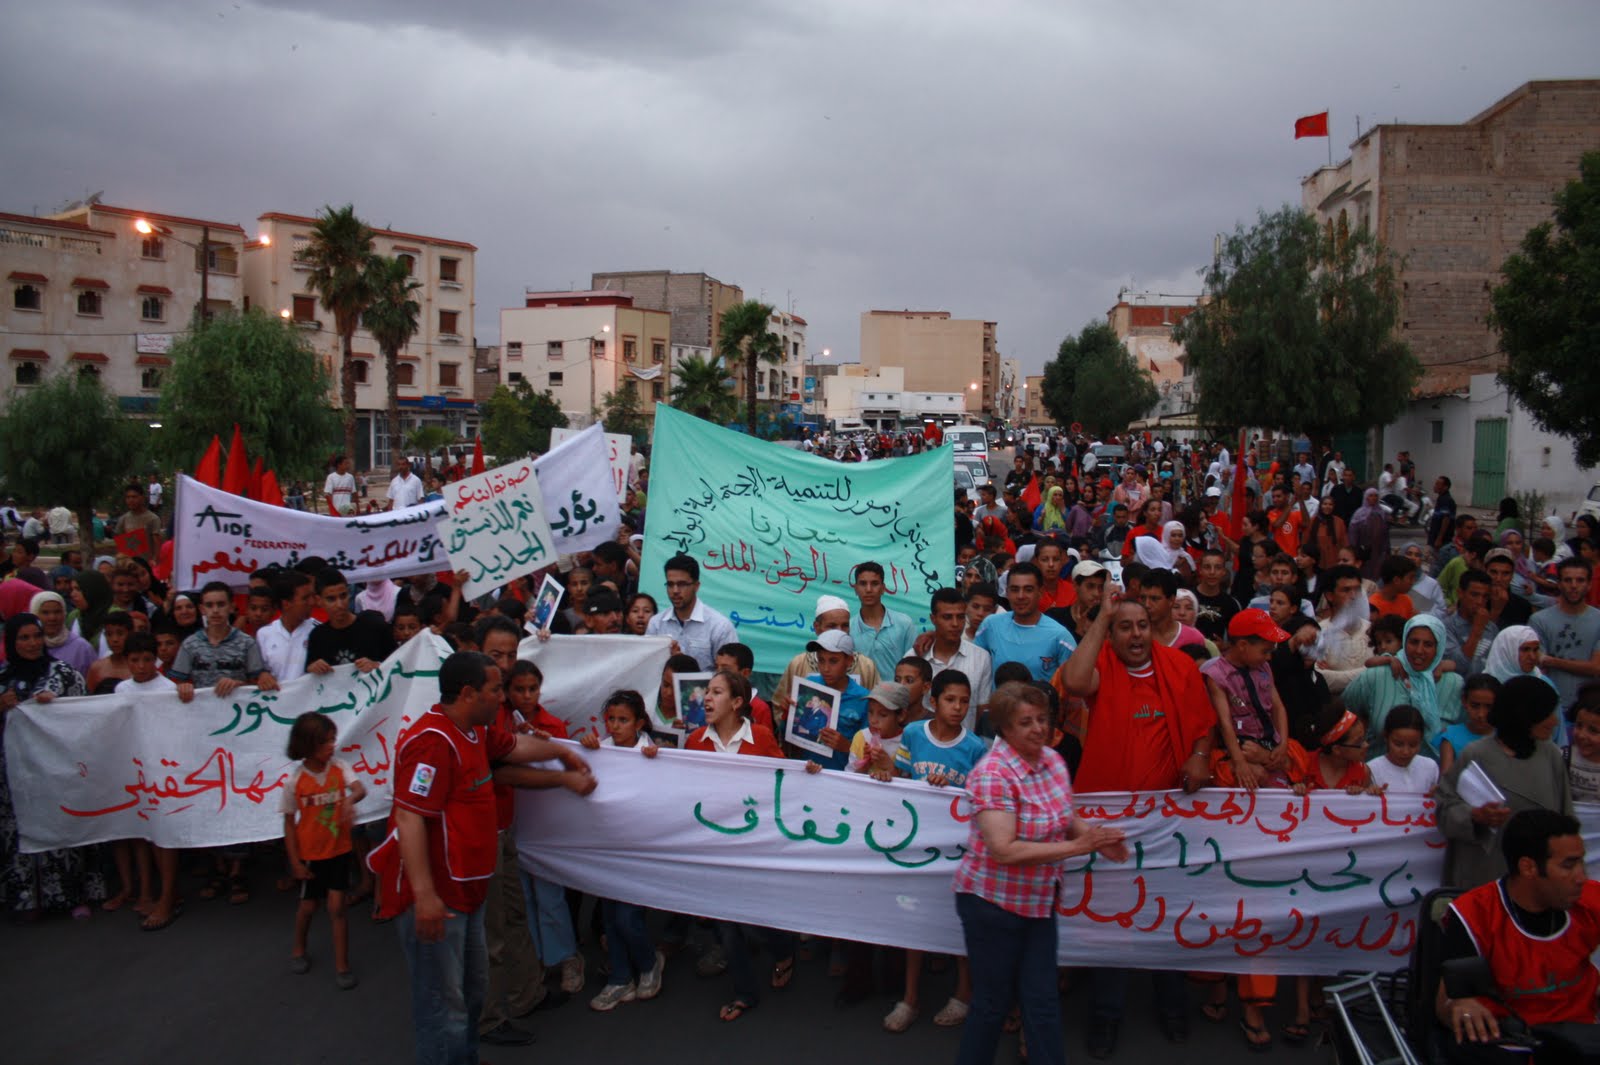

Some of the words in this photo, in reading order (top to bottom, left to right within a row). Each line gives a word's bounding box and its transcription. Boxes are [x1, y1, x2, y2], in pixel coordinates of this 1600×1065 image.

[767, 475, 852, 504] للتنمية
[194, 504, 253, 538] AIDE
[511, 493, 535, 534] نعم
[244, 538, 308, 550] FEDERATION
[469, 530, 547, 583] الجديد
[702, 539, 757, 573] الملك
[766, 544, 829, 594] الوطن
[1173, 898, 1321, 958] الوطن
